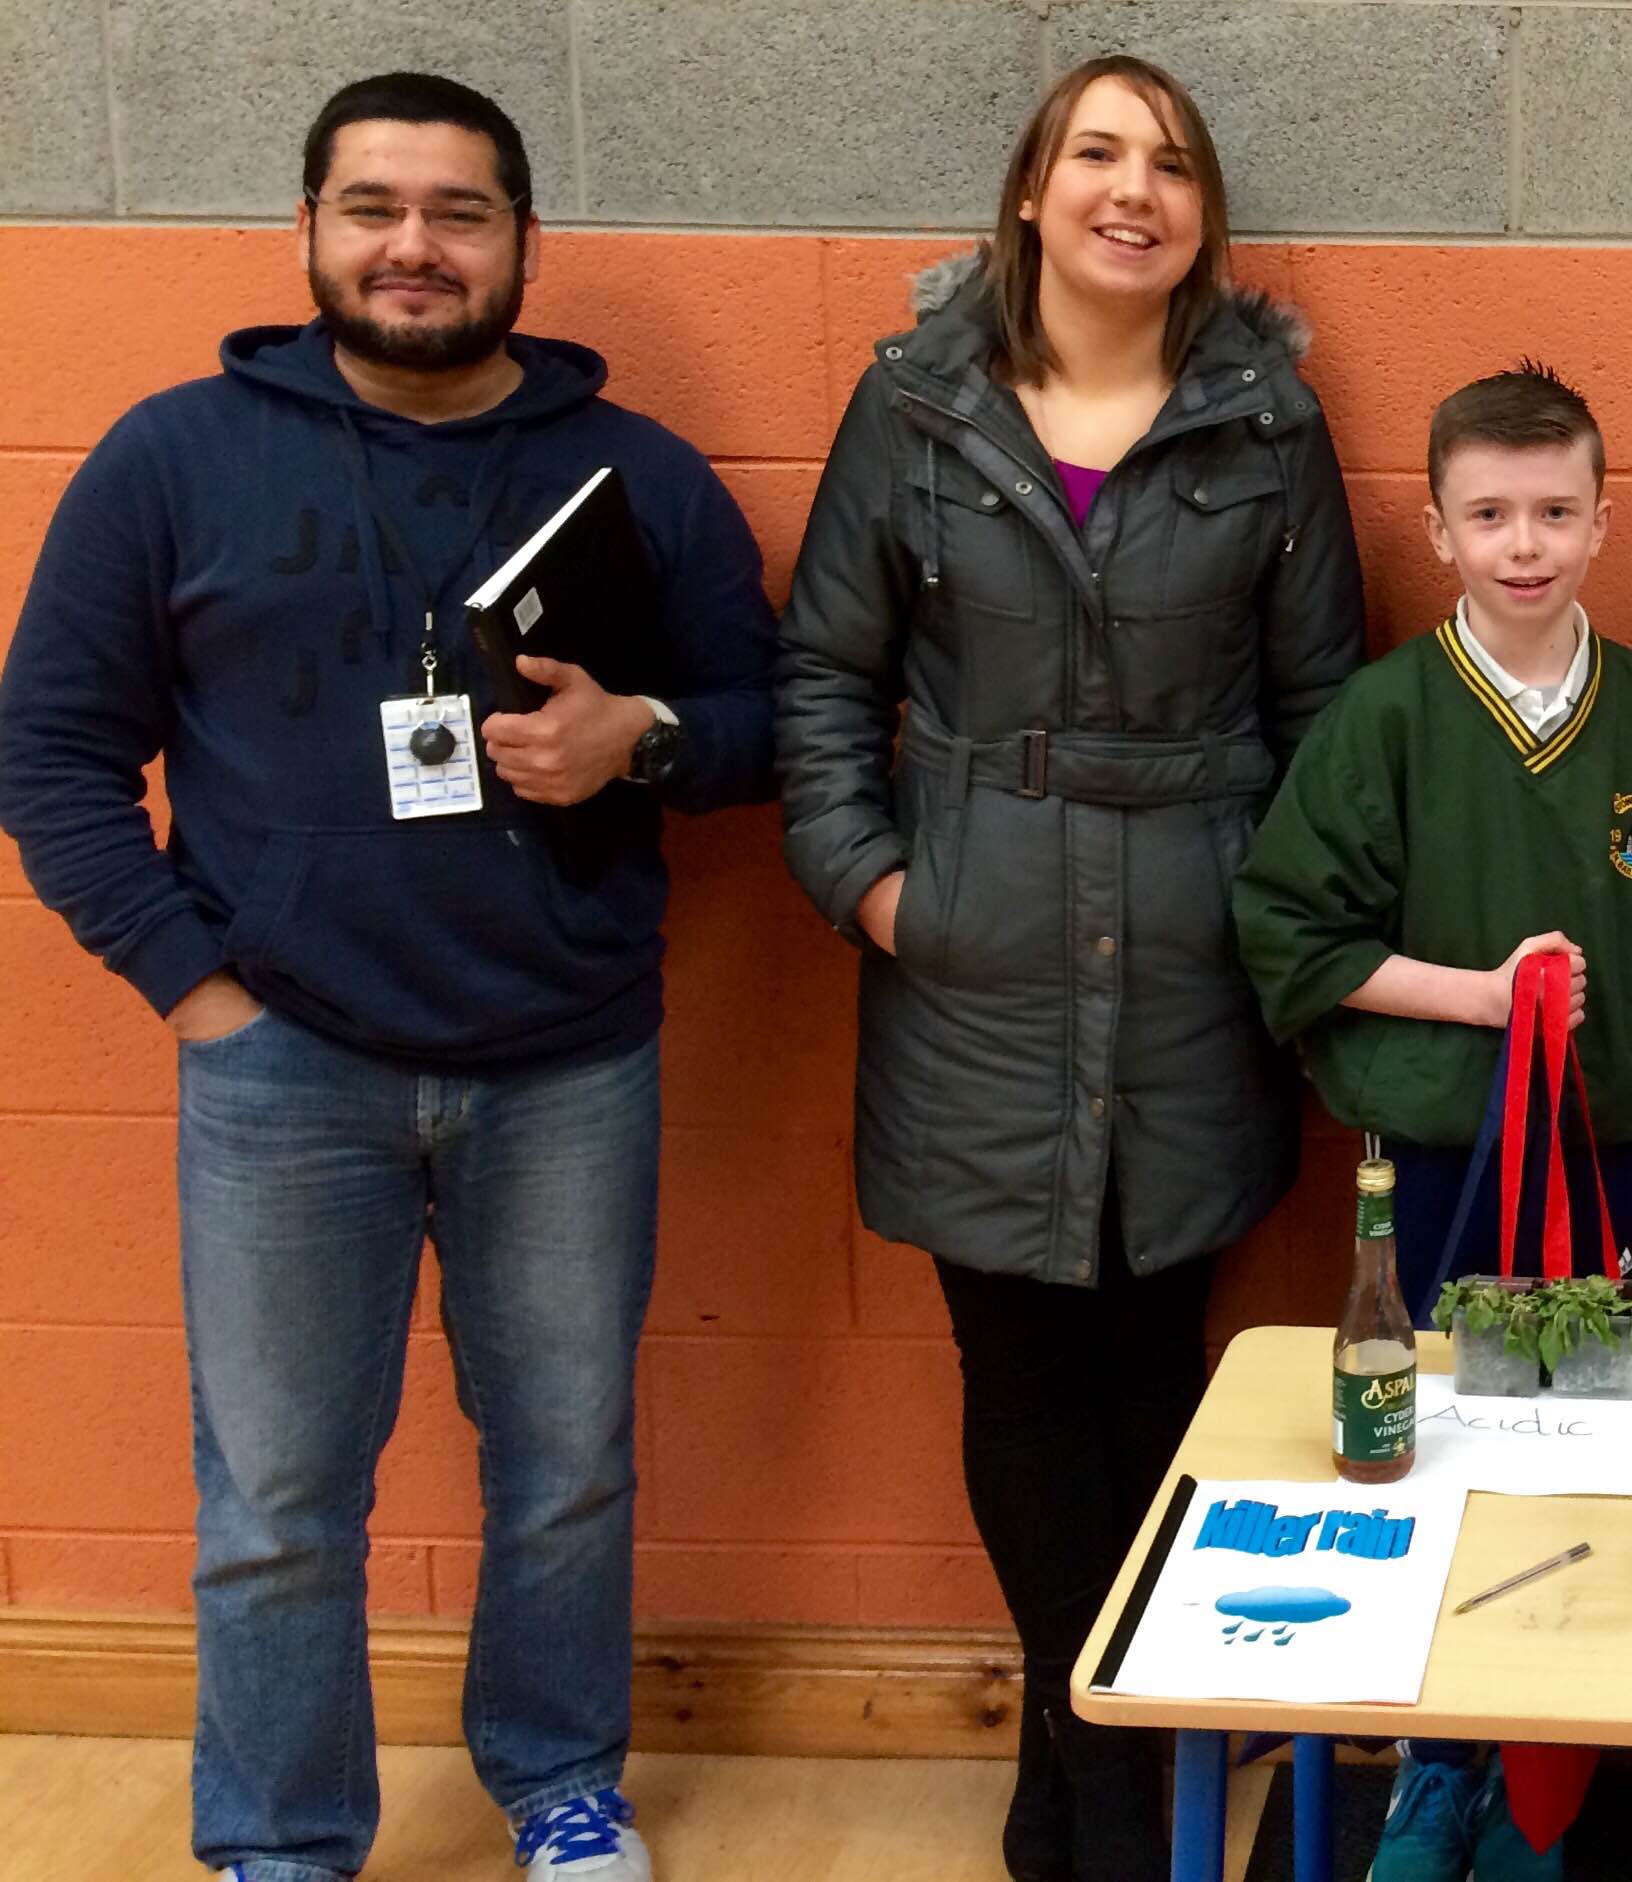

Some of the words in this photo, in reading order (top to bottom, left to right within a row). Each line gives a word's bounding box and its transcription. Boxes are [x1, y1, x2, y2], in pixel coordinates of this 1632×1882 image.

[1417, 1404, 1593, 1436] Acidic
[1193, 1499, 1324, 1558] killer
[1315, 1508, 1416, 1560] rain
